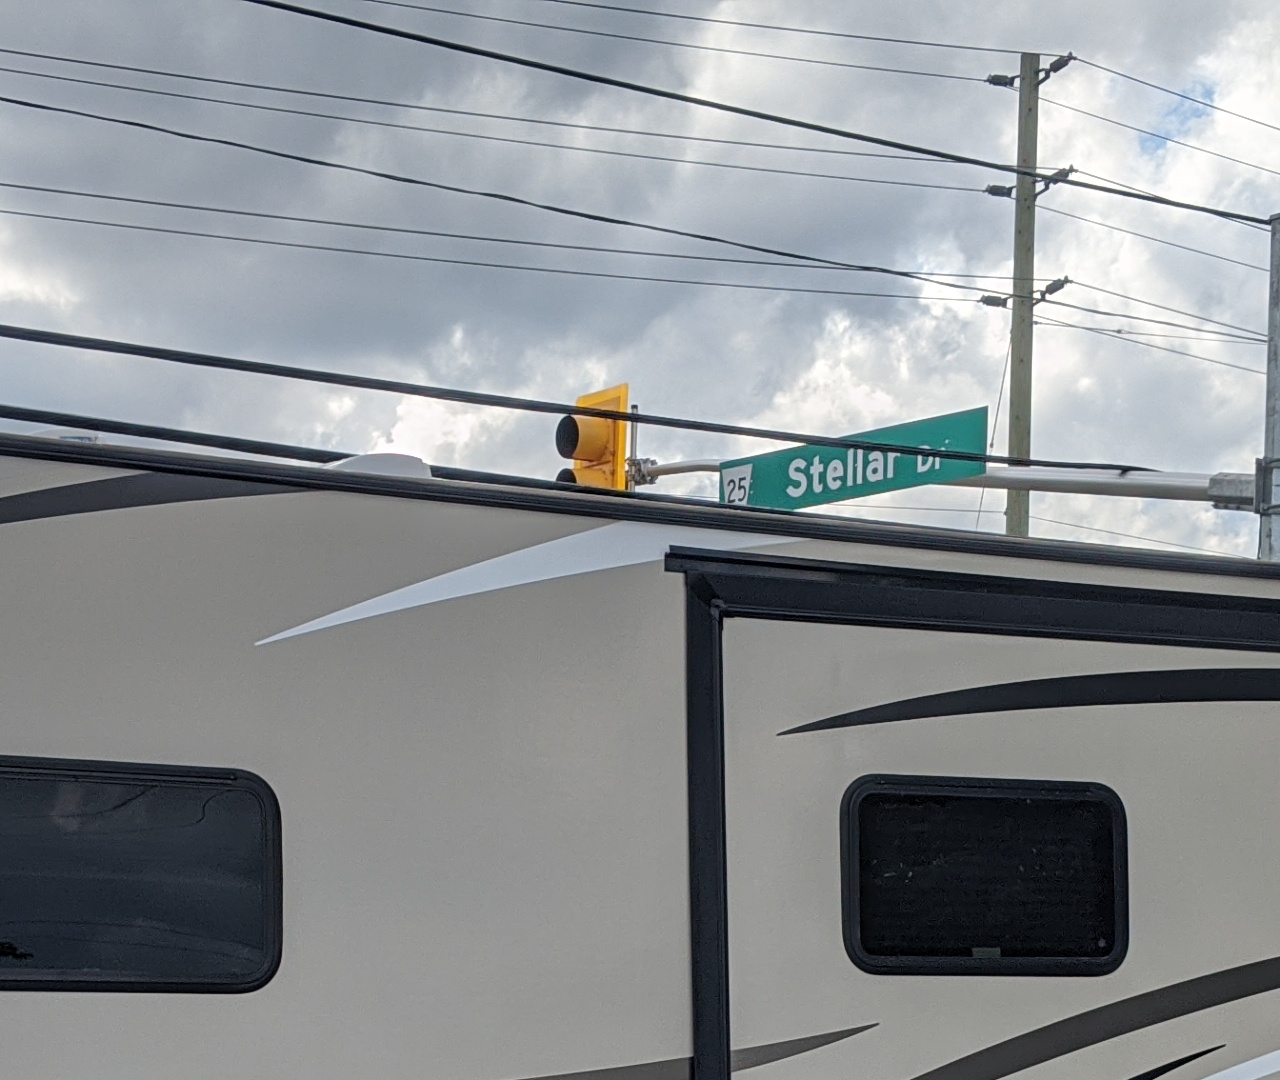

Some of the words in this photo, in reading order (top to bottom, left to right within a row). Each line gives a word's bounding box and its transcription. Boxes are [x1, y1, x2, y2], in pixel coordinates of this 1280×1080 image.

[726, 476, 747, 504] 25
[785, 447, 901, 498] Stellar
[916, 444, 942, 473] Dr
